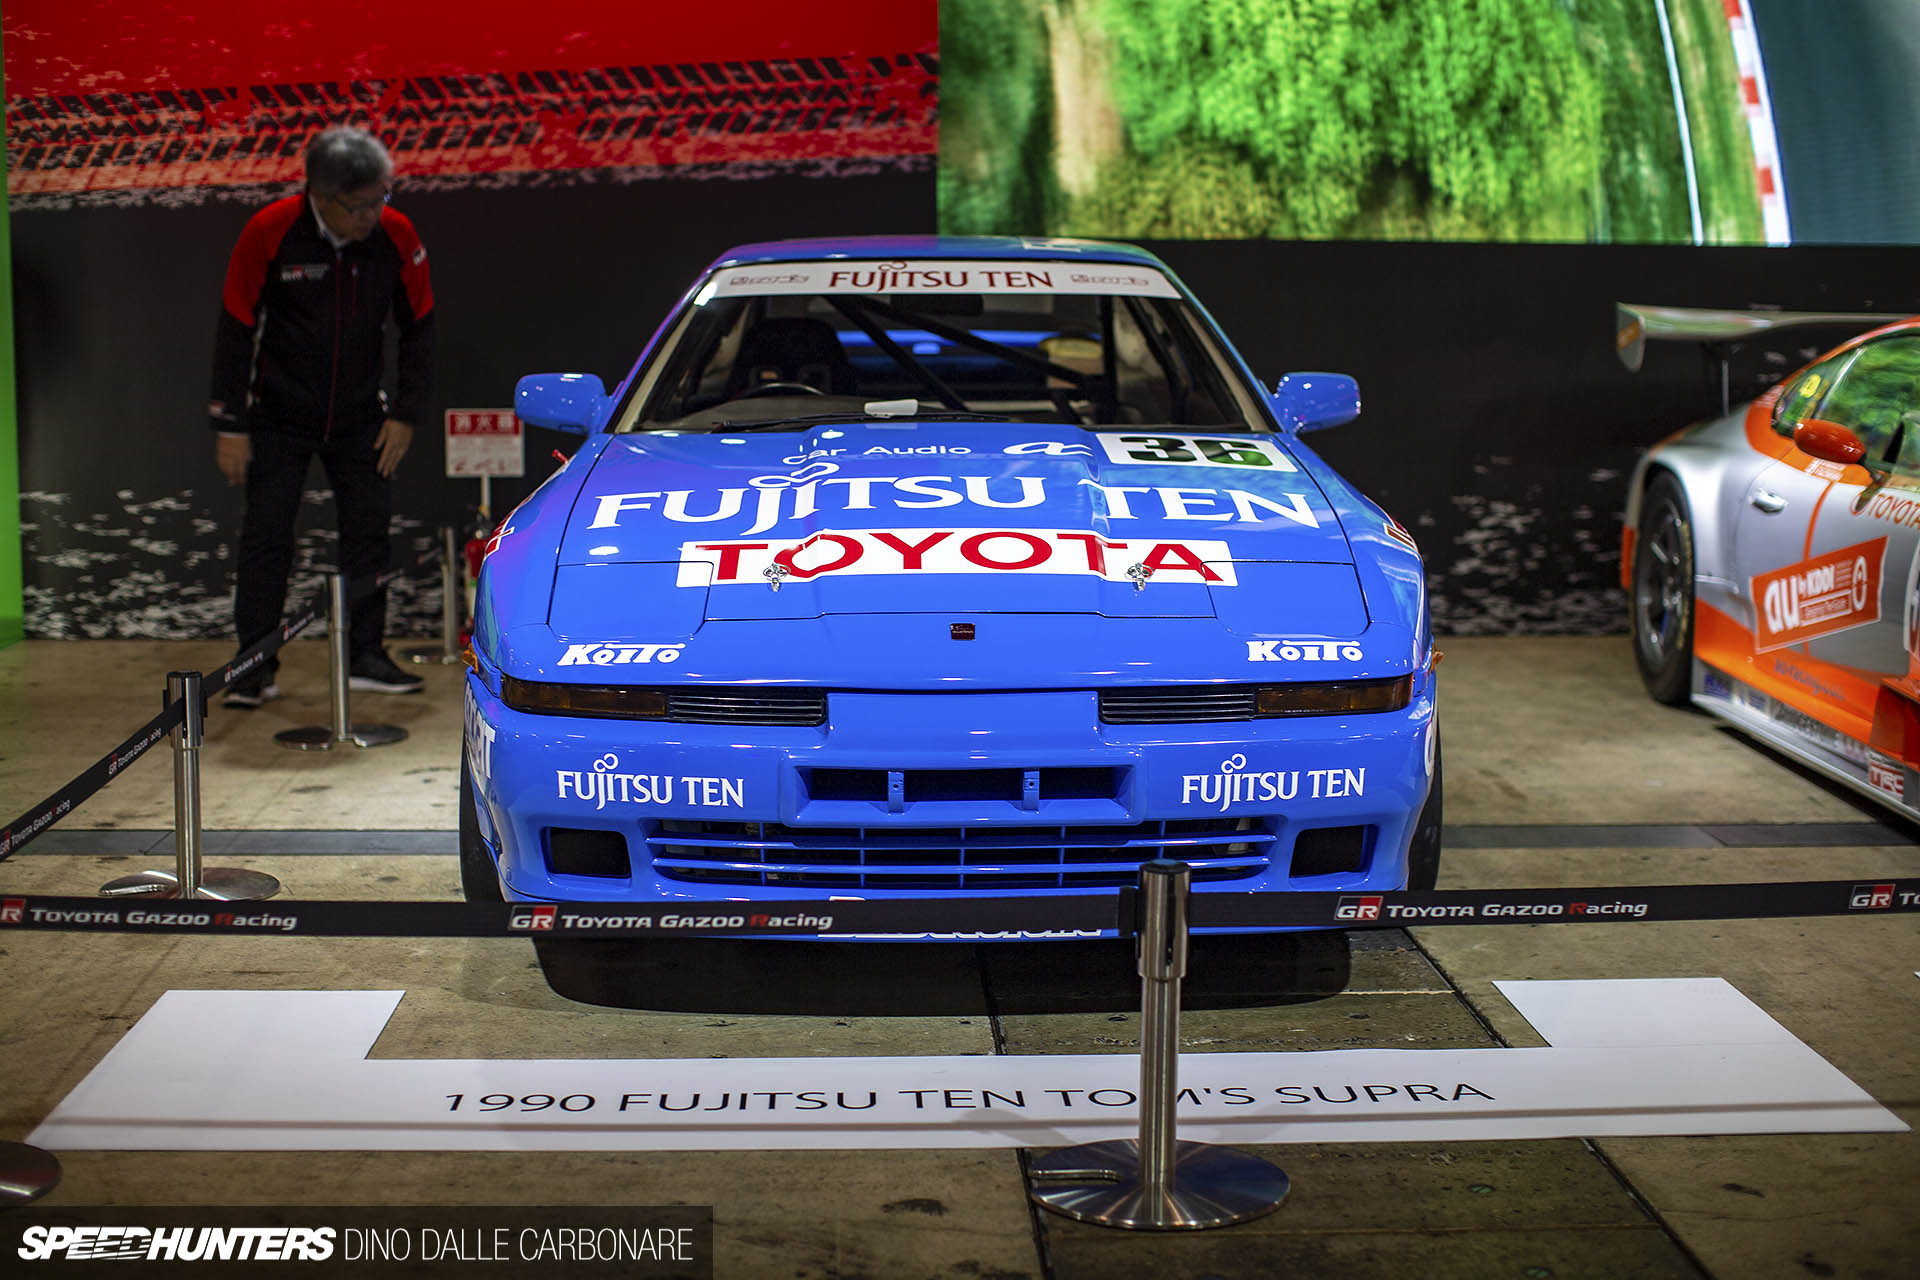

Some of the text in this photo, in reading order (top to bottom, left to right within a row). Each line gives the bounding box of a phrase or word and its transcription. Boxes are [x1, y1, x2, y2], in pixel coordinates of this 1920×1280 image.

[829, 260, 968, 292] FUJITSU
[979, 271, 1053, 288] TEN
[782, 447, 848, 465] Car
[863, 444, 972, 456] Audio
[1118, 436, 1273, 467] 36
[585, 461, 1047, 536] FUJITSU
[1077, 478, 1320, 529] TEN
[695, 531, 1224, 582] TOYOTA
[556, 753, 744, 810] FUJITSU TEN
[1181, 753, 1366, 813] FUJITSU TEN
[1336, 901, 1649, 919] GR TOYOTA GAZOO Racing
[1851, 893, 1892, 907] GR
[30, 908, 119, 924] TOYOTA
[126, 911, 210, 926] GAZOO
[215, 913, 298, 931] Racing
[510, 913, 834, 930] GR TOYOTA GAZOO Racing
[445, 1093, 596, 1112] 1990
[618, 1091, 877, 1112] FUJITSU
[899, 1089, 1025, 1108] TEN
[1273, 1083, 1496, 1104] SUPRA
